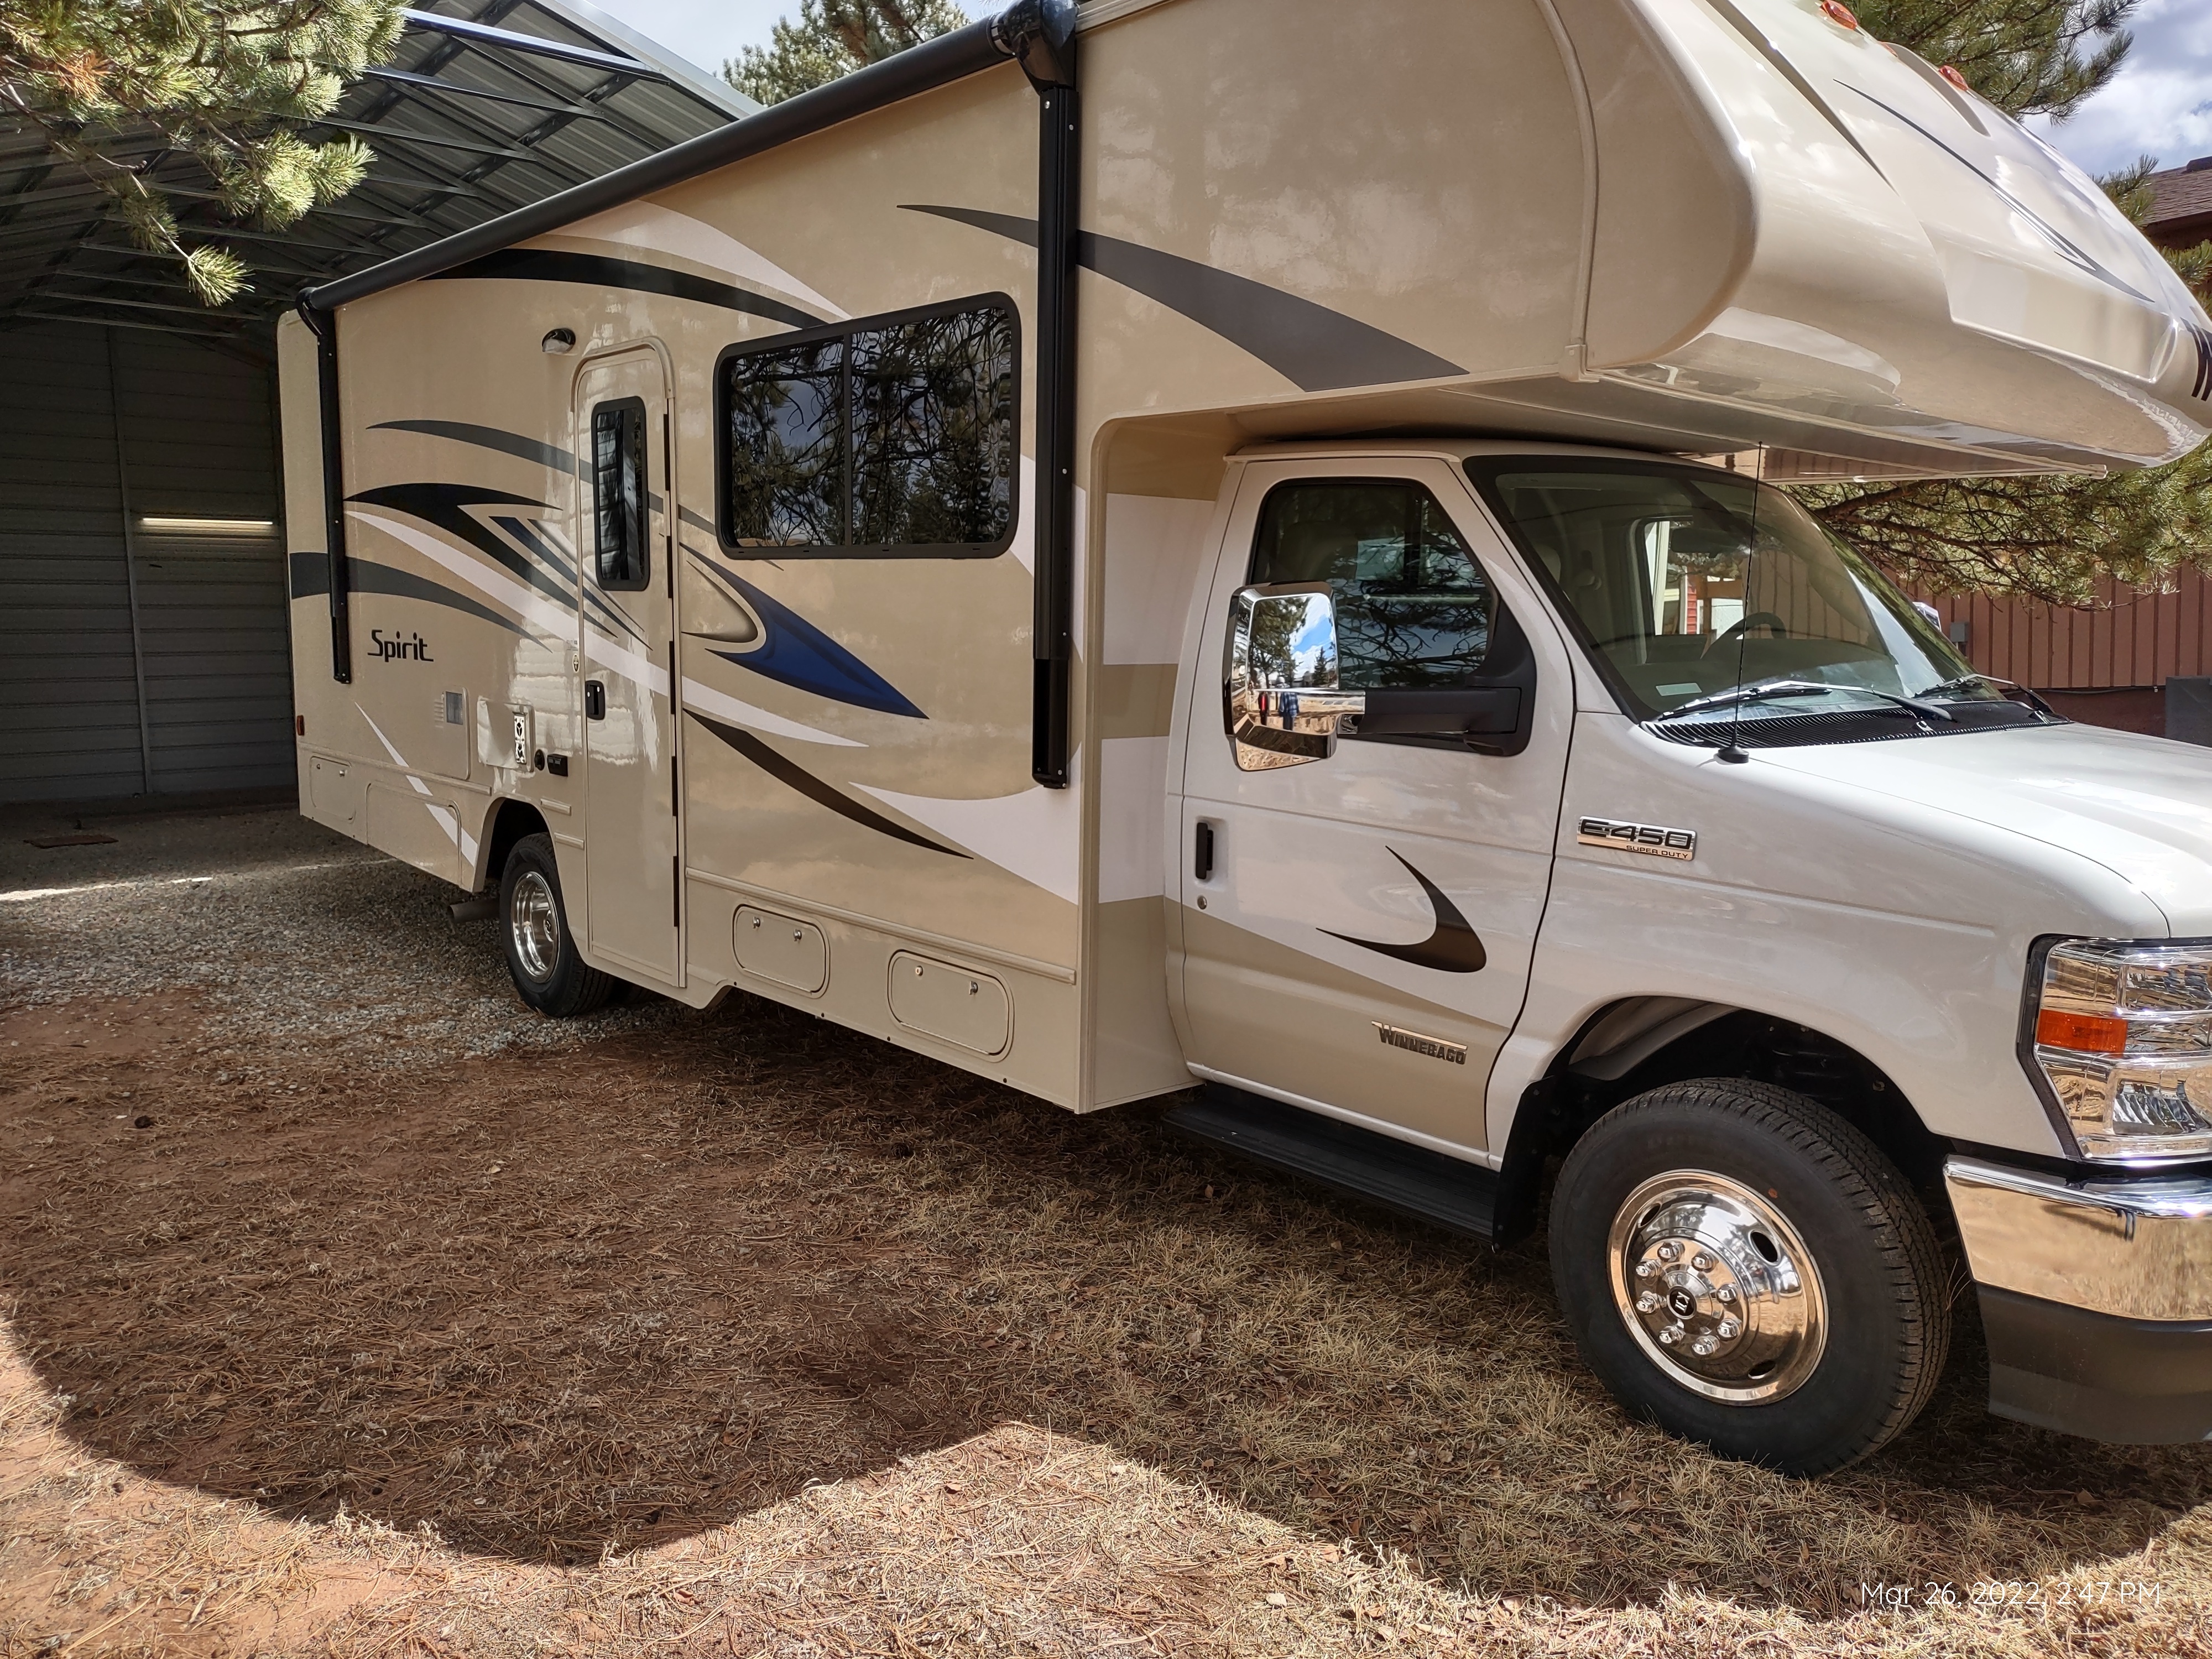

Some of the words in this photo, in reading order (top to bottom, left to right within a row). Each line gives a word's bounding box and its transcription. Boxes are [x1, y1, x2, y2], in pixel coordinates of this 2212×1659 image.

[367, 629, 434, 662] Spirit
[1580, 818, 1692, 849] E-450
[1626, 845, 1658, 854] SUPER
[1371, 1020, 1468, 1065] WINNEBAGO
